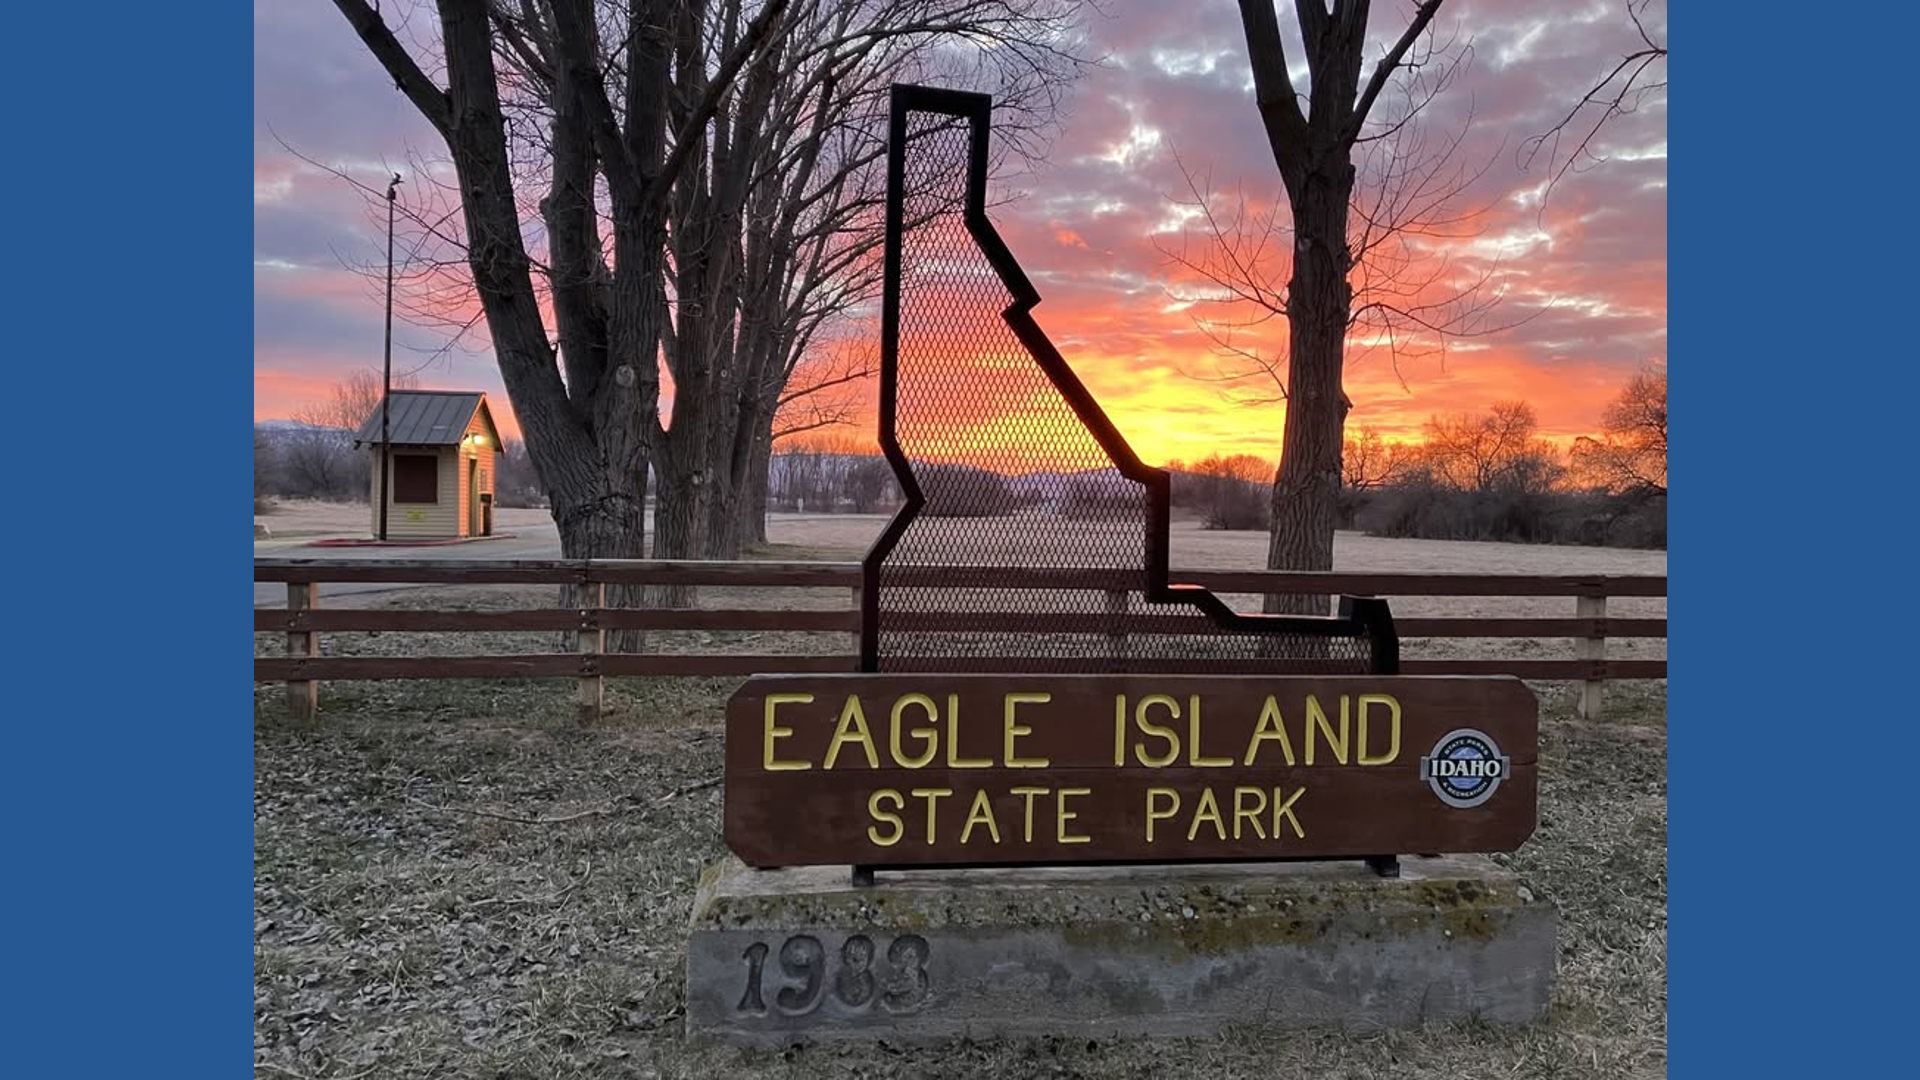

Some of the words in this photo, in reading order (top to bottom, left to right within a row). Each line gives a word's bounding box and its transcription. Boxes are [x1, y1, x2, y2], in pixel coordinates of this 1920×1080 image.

[763, 692, 1052, 771] EAGLE
[1114, 693, 1402, 769] ISLAND
[1444, 739, 1465, 755] STATE
[1467, 738, 1489, 756] PARKS
[1431, 759, 1502, 777] IDAHO
[867, 787, 1092, 847] STATE
[1145, 786, 1307, 843] PARK
[736, 934, 931, 1016] 1983
